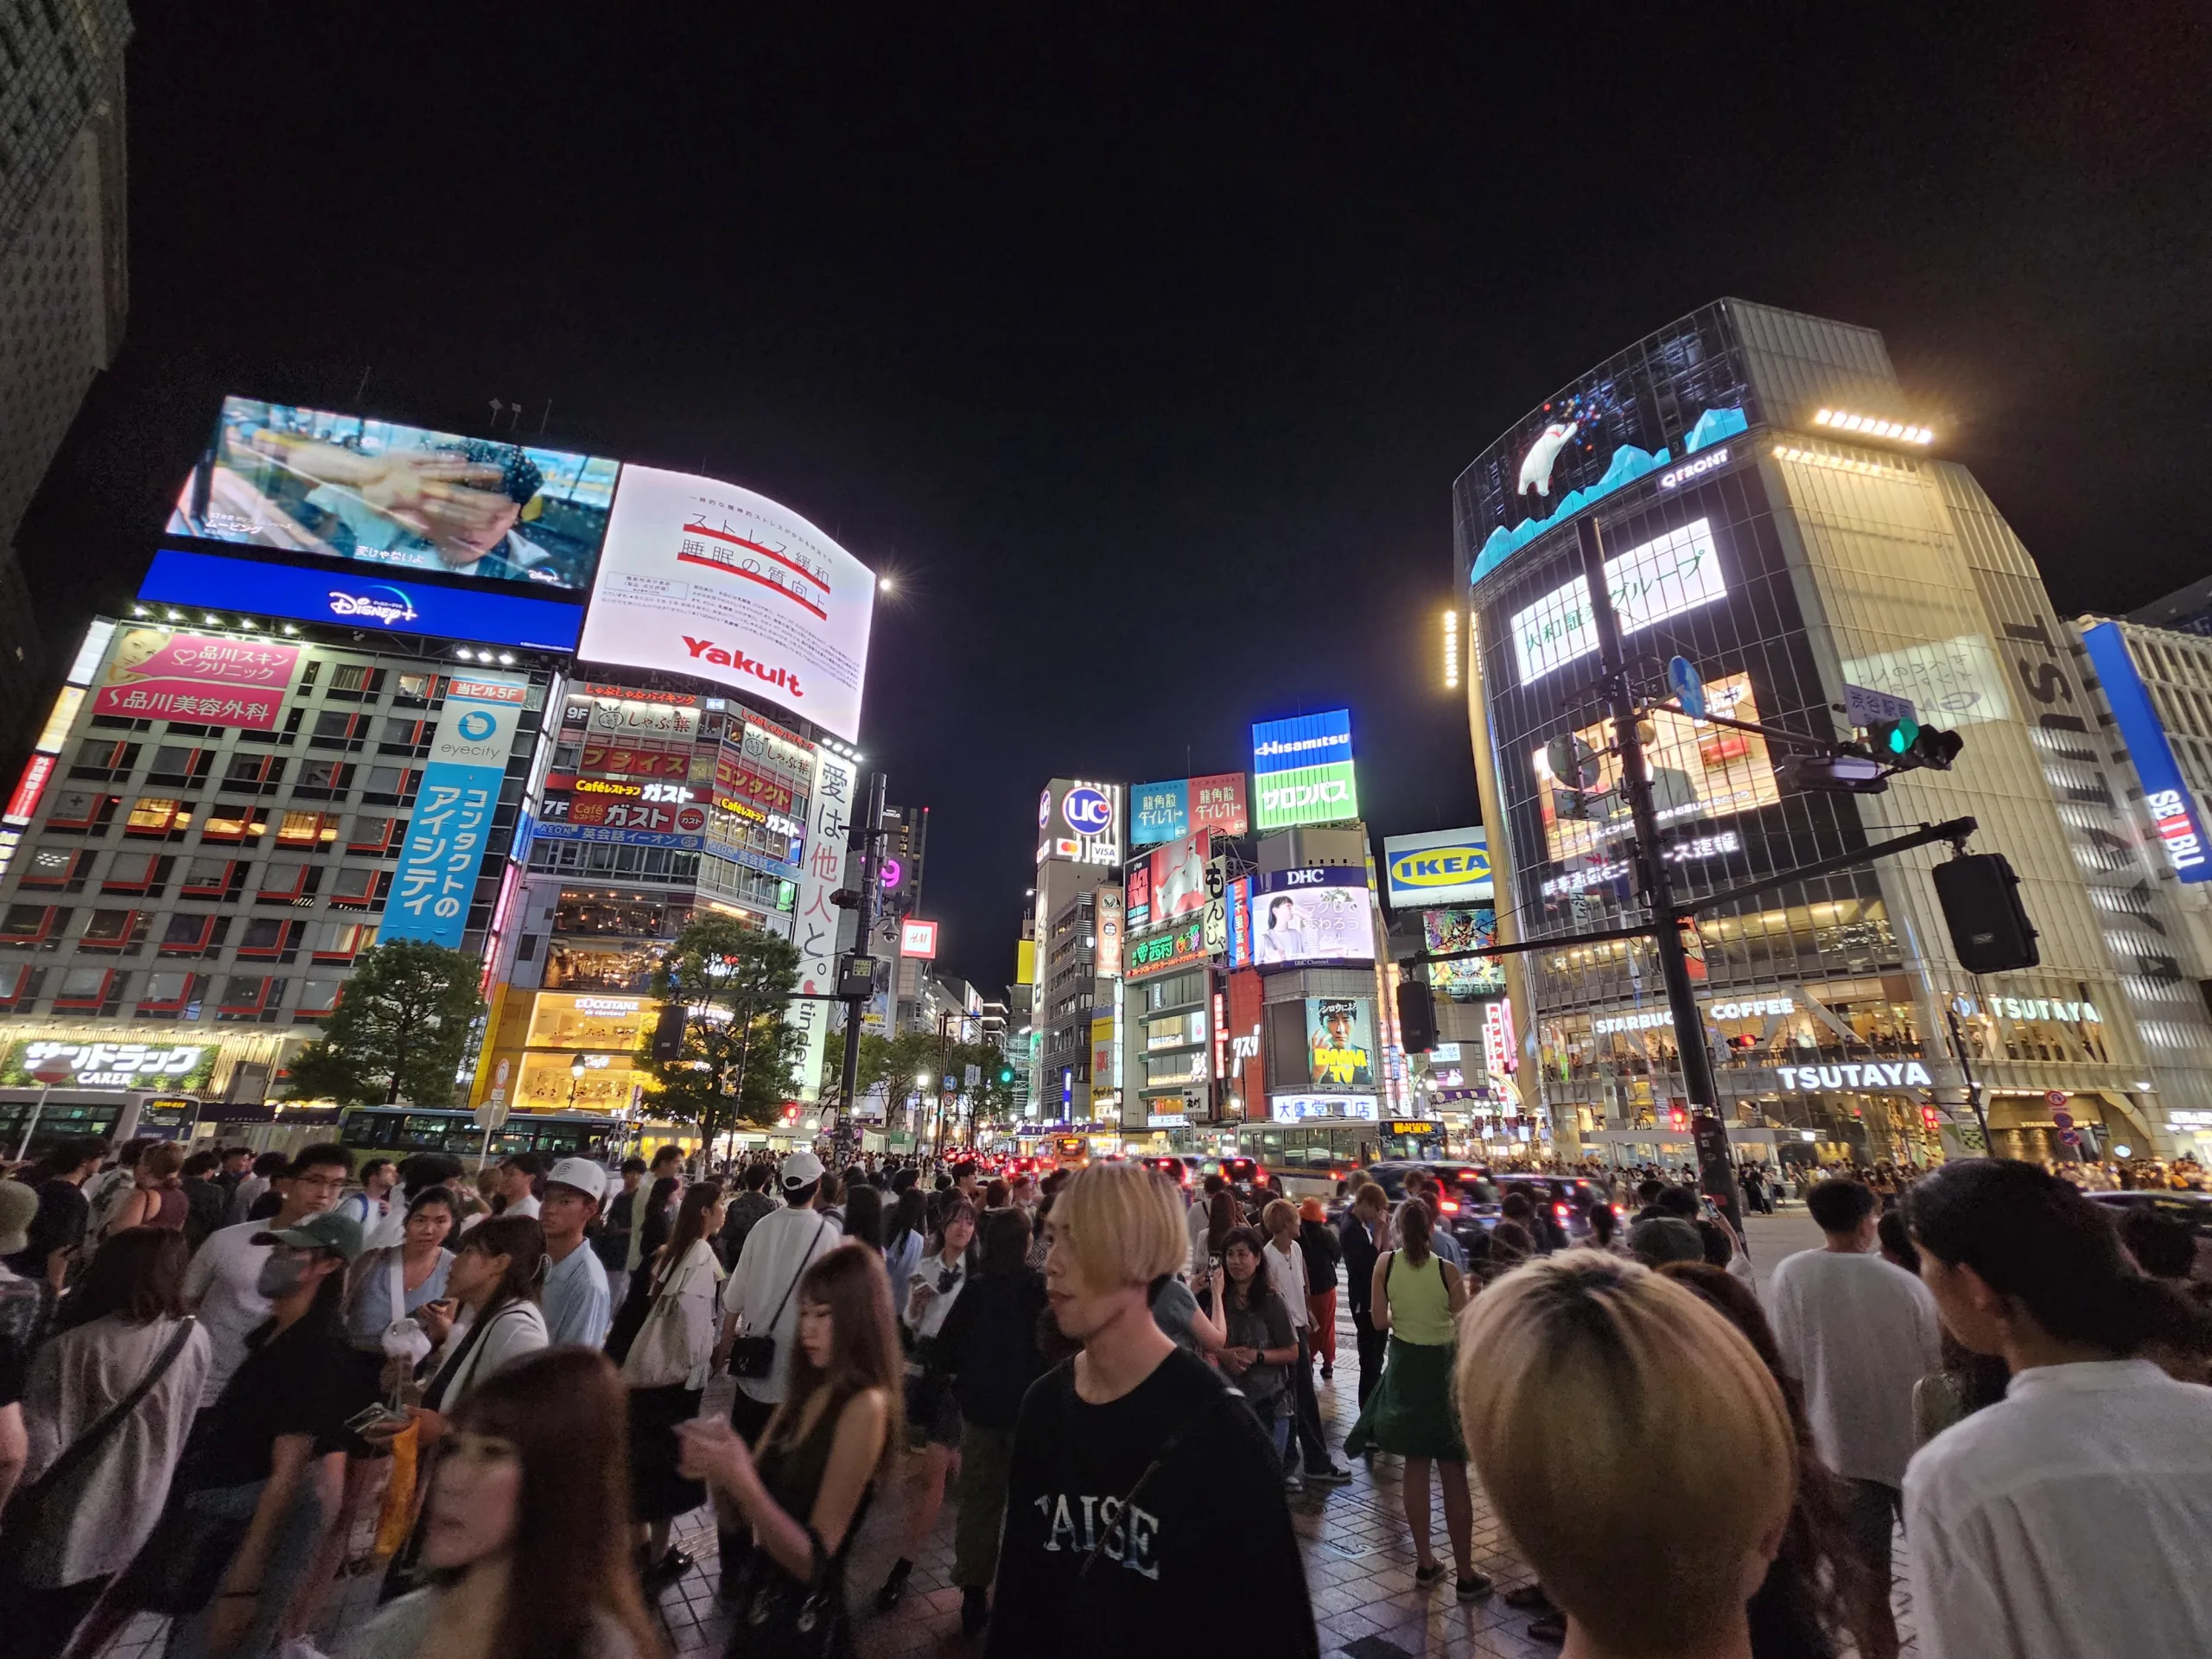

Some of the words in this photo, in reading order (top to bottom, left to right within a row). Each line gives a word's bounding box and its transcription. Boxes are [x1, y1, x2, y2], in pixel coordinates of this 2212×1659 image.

[1661, 448, 1728, 489] QFRONT
[355, 545, 425, 564] 変じゃないよ
[691, 512, 830, 588] ストレス緩和
[682, 538, 826, 613] 睡眠の質向上
[329, 592, 418, 626] Disney+
[1525, 549, 1706, 656] 大和証グループ
[198, 645, 290, 667] 品川スキン
[681, 635, 804, 698] Yakult
[194, 660, 275, 681] クリニック
[455, 682, 518, 701] 当ビル5F
[585, 683, 698, 706] しゃぶしゃぶバイキング
[122, 690, 270, 722] 品川美容外科
[566, 706, 589, 721] 9F
[628, 710, 692, 734] しゃぶ葉
[441, 741, 501, 760] eyecity
[1255, 733, 1350, 756] Hisamitsu
[583, 748, 686, 775] プライス
[641, 783, 695, 804] ガスト
[715, 763, 791, 807] コンタクト
[1199, 785, 1235, 804] 龍角散
[1262, 779, 1349, 811] サロンパス
[543, 800, 569, 816] 7F
[575, 803, 603, 816] Café
[1142, 792, 1176, 810] 龍角散
[604, 804, 670, 829] ガスト
[765, 813, 800, 838] ガスト
[539, 824, 573, 836] AEON
[581, 827, 677, 845] 英会話イーオン
[2148, 789, 2206, 870] SEIBU
[401, 785, 461, 917] アイシティ
[434, 788, 487, 918] コンタクトの
[1094, 847, 1115, 856] VISA
[804, 760, 849, 977] 愛は他人と。
[1287, 868, 1324, 885] DHC
[1401, 855, 1490, 879] IKEA
[1205, 861, 1226, 950] もんじゃ
[1303, 917, 1365, 932] 変わろう。
[910, 932, 928, 944] H&M
[1149, 941, 1173, 962] 西村
[575, 997, 639, 1011] L'OCCITANE
[1710, 998, 1796, 1020] COFFEE
[1990, 997, 2103, 1023] TSUTAYA
[1595, 1010, 1675, 1034] STARBUC
[791, 1001, 817, 1072] tinder
[24, 1041, 201, 1075] サンドラッグ
[1314, 1048, 1367, 1067] DMM
[1329, 1065, 1355, 1083] TV
[1777, 1062, 1932, 1090] TSUTAYA
[1034, 1493, 1160, 1580] AISE
